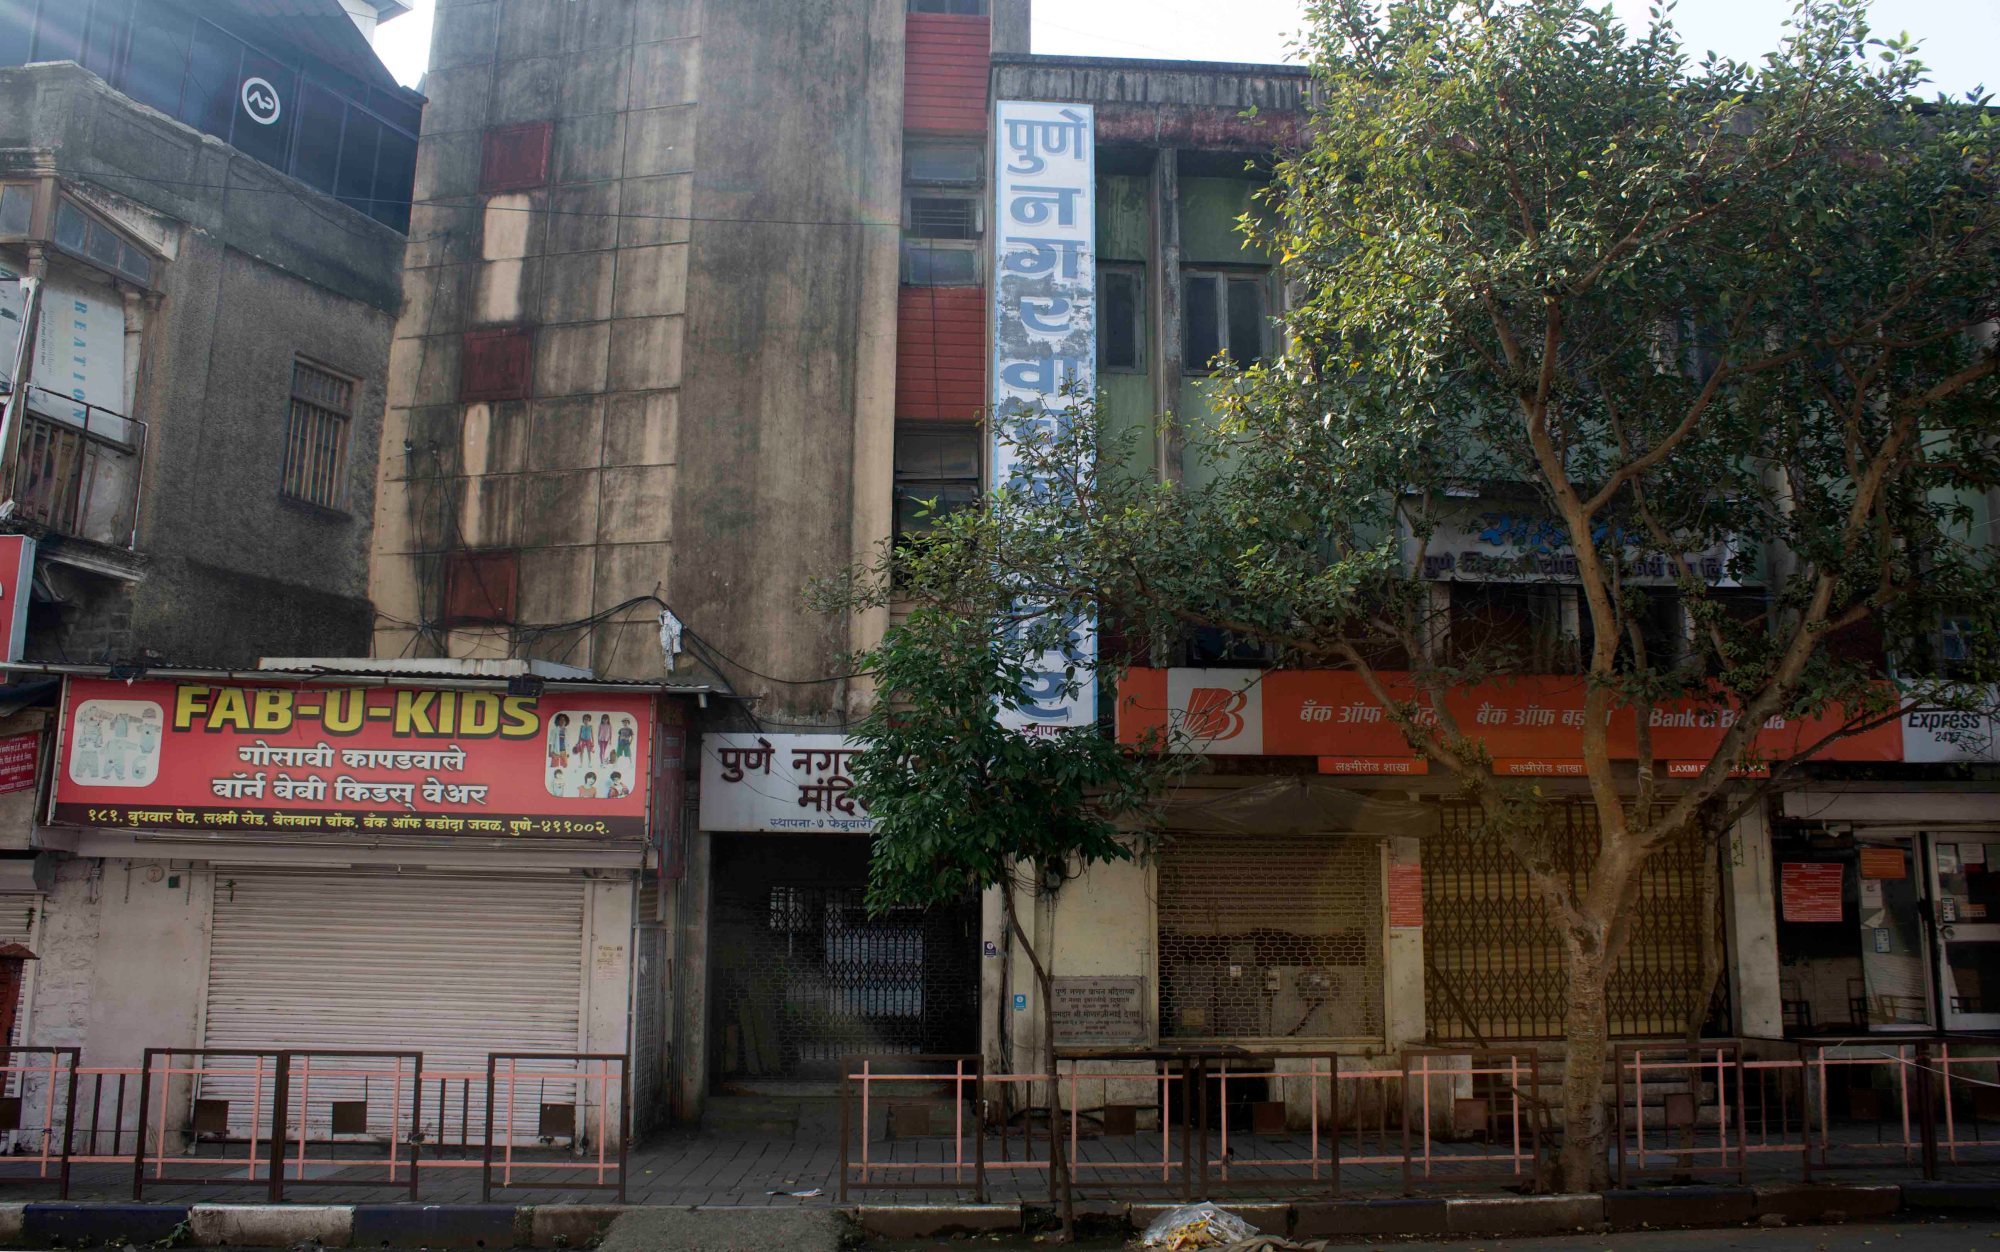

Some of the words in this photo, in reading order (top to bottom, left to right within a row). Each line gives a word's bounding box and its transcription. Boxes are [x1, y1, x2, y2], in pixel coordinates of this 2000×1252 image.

[1004, 108, 1087, 175] पुणे
[1003, 185, 1086, 337] नगर
[174, 685, 541, 737] FAB-U-KIDS
[1299, 699, 1333, 723] बँक
[1337, 702, 1383, 723] ऑफ
[1476, 701, 1508, 726] बैंक
[1513, 704, 1555, 727] ऑफ़
[1649, 708, 1697, 728] Bank
[1908, 712, 1981, 733] Express
[238, 740, 335, 768] गोसावी
[342, 744, 466, 771] कापडवाले
[718, 737, 775, 782] पुणे
[1335, 760, 1380, 773] लक्ष्मीरोड
[1383, 761, 1410, 773] शाखा
[1510, 761, 1554, 774] लक्ष्मीरोड
[1557, 763, 1584, 774] शाखा
[1669, 764, 1698, 773] LAXMI
[212, 773, 268, 799] बॉर्न
[273, 774, 327, 800] बेबी
[335, 775, 417, 811] किडस्
[422, 777, 488, 805] वेअर
[128, 810, 173, 827] बुधवार
[203, 810, 238, 826] लक्ष्मी
[272, 811, 322, 827] बेलबाग
[363, 812, 388, 828] बँक
[391, 814, 422, 829] ऑफ
[425, 815, 464, 832] बडोदा
